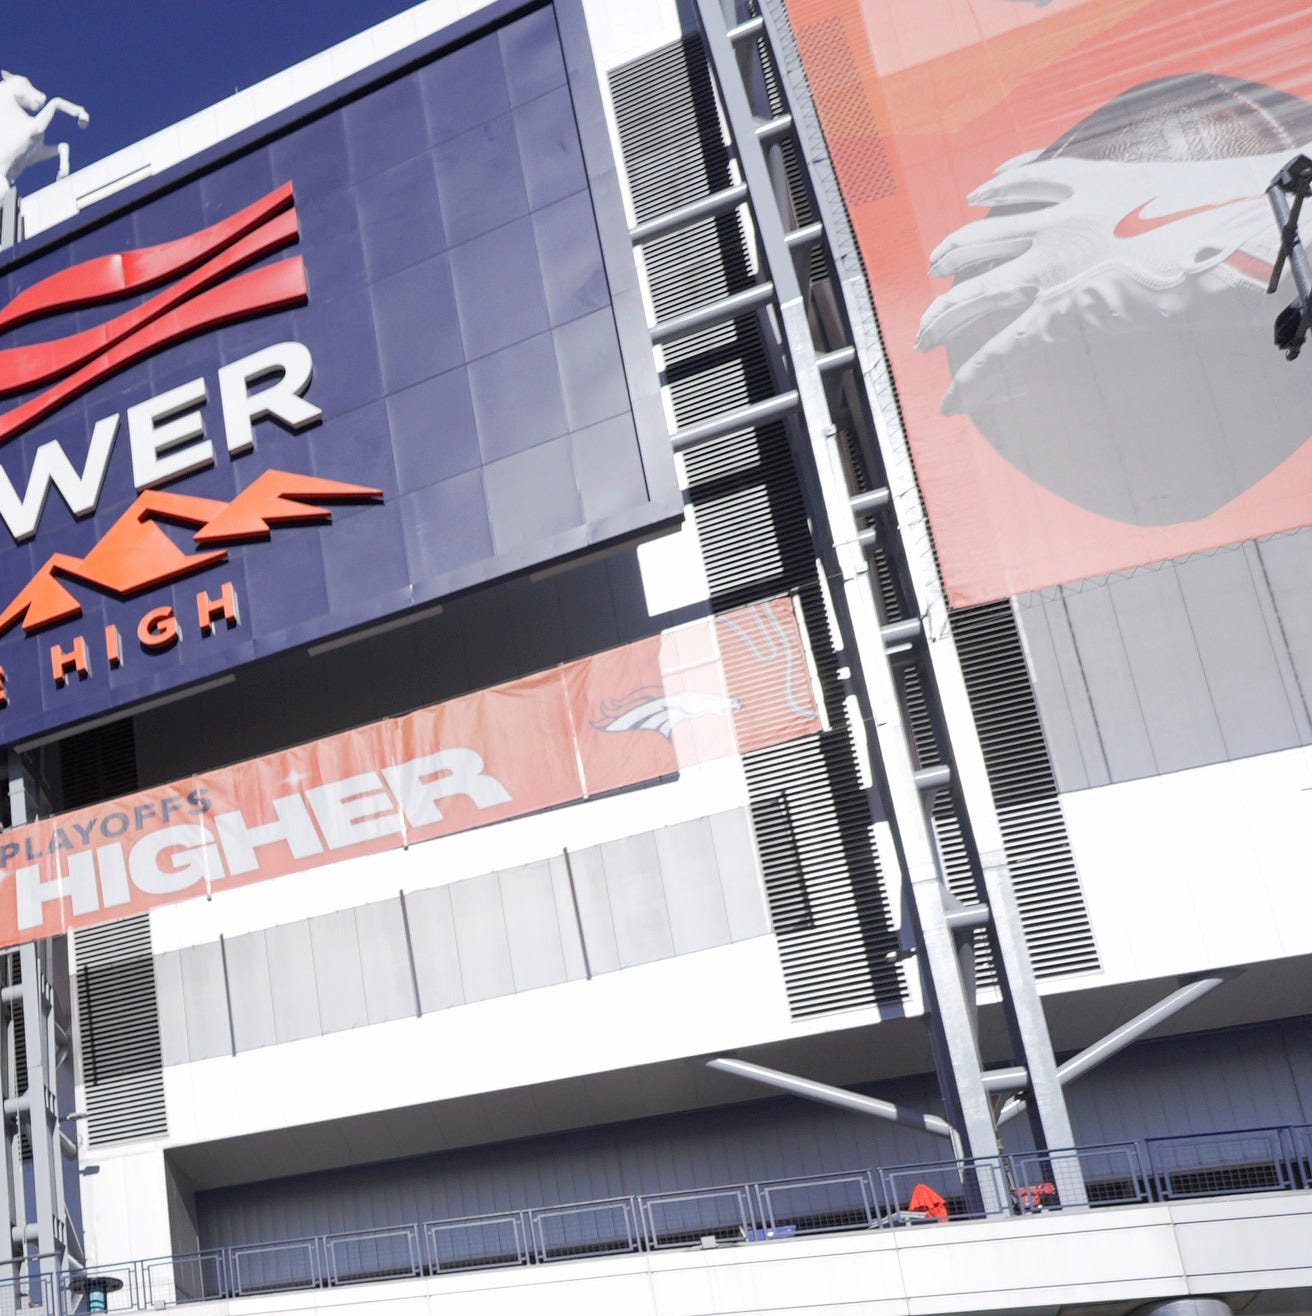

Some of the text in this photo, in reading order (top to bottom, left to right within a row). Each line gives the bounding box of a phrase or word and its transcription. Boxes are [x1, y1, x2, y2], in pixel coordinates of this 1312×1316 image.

[49, 582, 239, 688] HIGH
[0, 788, 212, 869] PLAYOFFS
[17, 747, 511, 929] HIGHER
